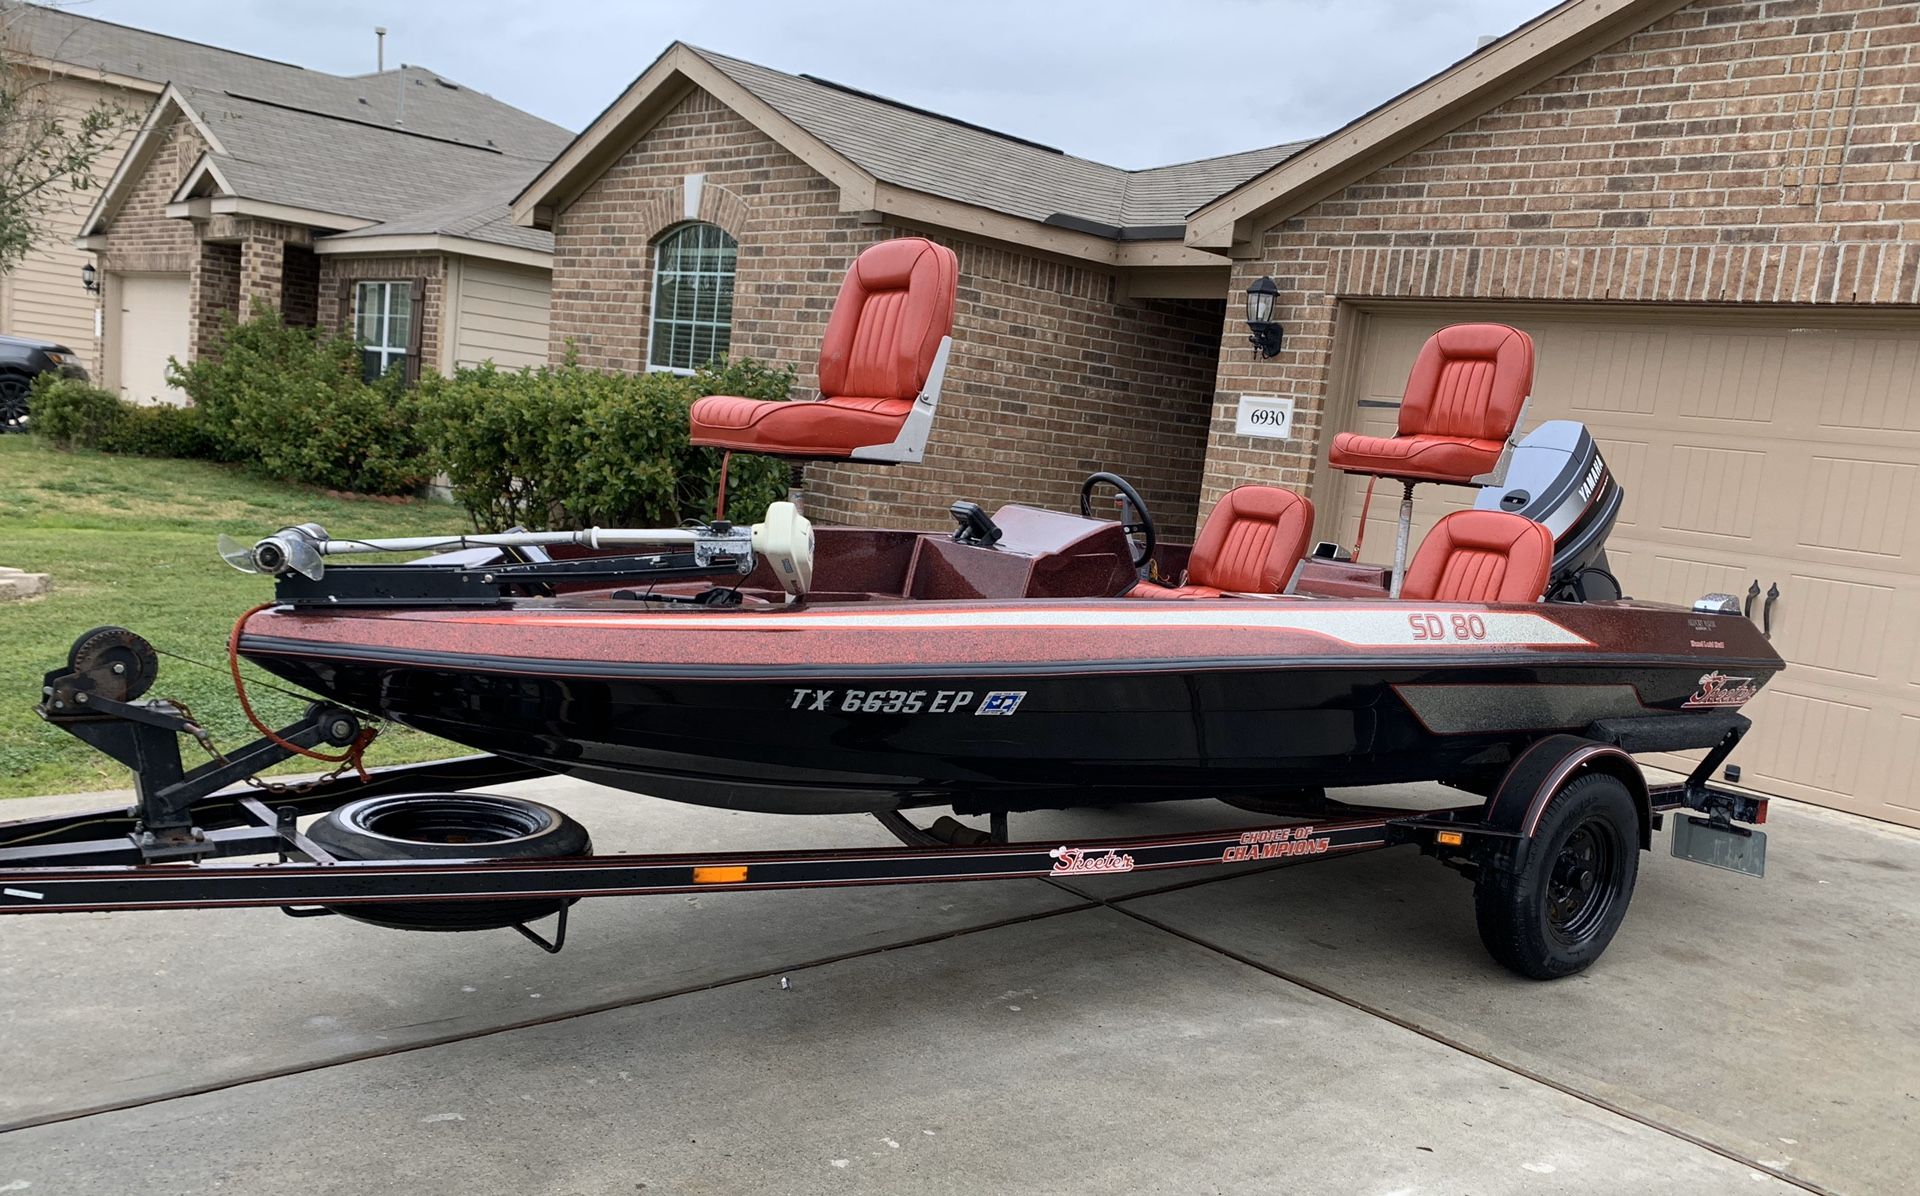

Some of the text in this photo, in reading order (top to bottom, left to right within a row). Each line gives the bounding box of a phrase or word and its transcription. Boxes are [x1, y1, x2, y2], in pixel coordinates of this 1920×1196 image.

[1251, 409, 1285, 426] 6930
[1578, 454, 1604, 503] YAMAHA
[1408, 613, 1487, 641] SD 80
[790, 688, 834, 711] TX
[841, 689, 928, 713] 6635
[928, 690, 974, 713] EP
[1240, 826, 1314, 845] CHOICE OF
[1053, 848, 1134, 873] Skeeter
[1222, 837, 1331, 863] CHAMPIONS
